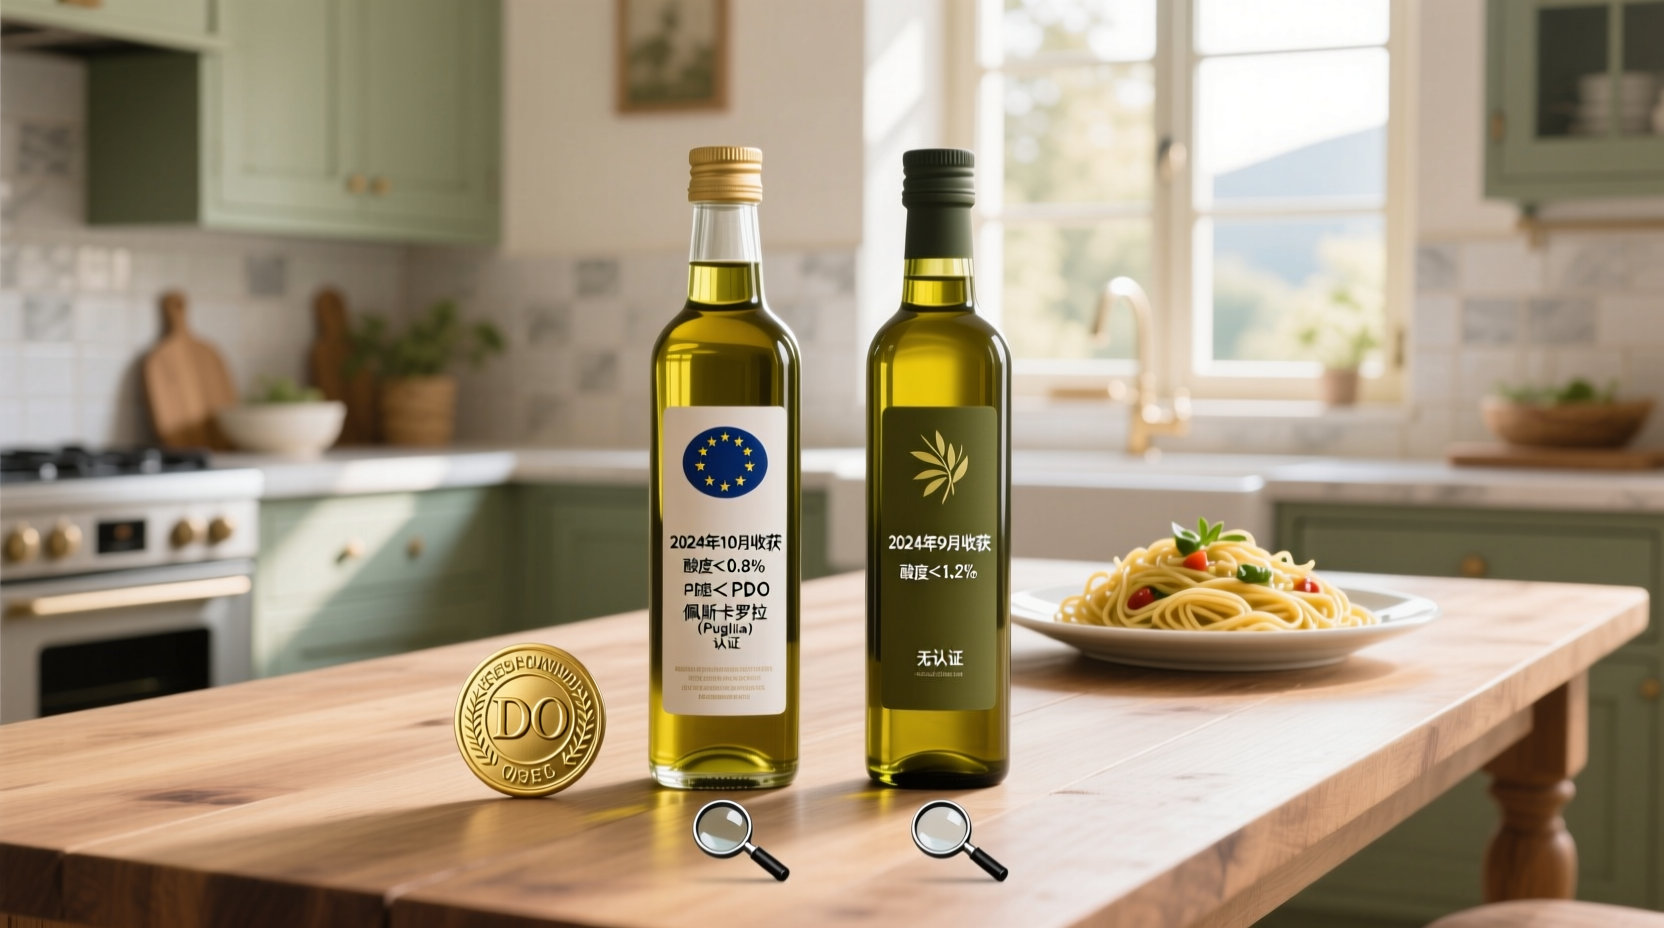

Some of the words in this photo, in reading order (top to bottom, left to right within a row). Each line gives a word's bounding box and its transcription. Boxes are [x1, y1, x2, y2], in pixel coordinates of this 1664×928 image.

[888, 534, 992, 552] 2024年9月收获
[917, 648, 964, 667] 无认证
[493, 696, 569, 741] DO
